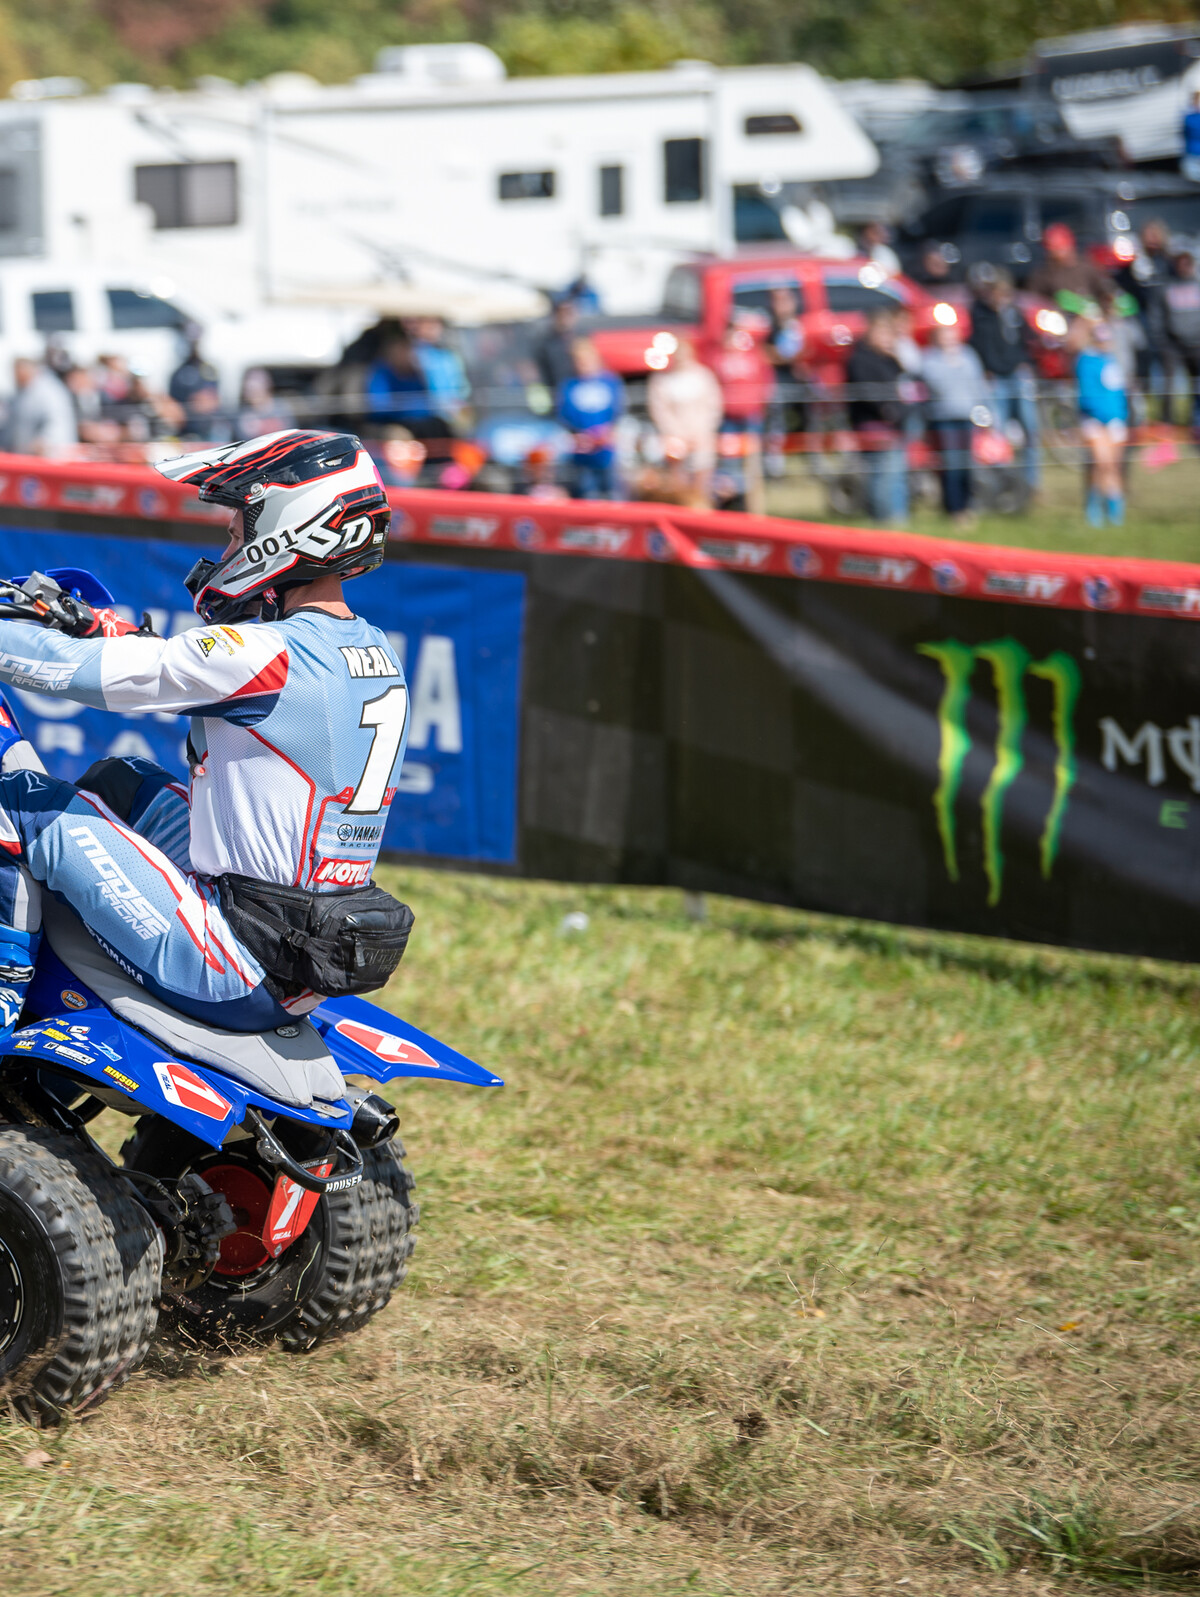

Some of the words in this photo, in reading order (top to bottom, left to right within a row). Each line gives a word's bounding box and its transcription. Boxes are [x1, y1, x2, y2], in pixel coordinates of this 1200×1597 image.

[246, 529, 299, 563] 001
[11, 674, 71, 691] RACING
[339, 645, 400, 678] NEAL
[341, 685, 407, 816] 1
[68, 826, 172, 937] MOOSE
[95, 881, 155, 940] RACING
[95, 935, 145, 985] YAMAHA
[172, 1074, 227, 1110] 1
[325, 1174, 363, 1193] HOUSER
[274, 1183, 306, 1231] 1
